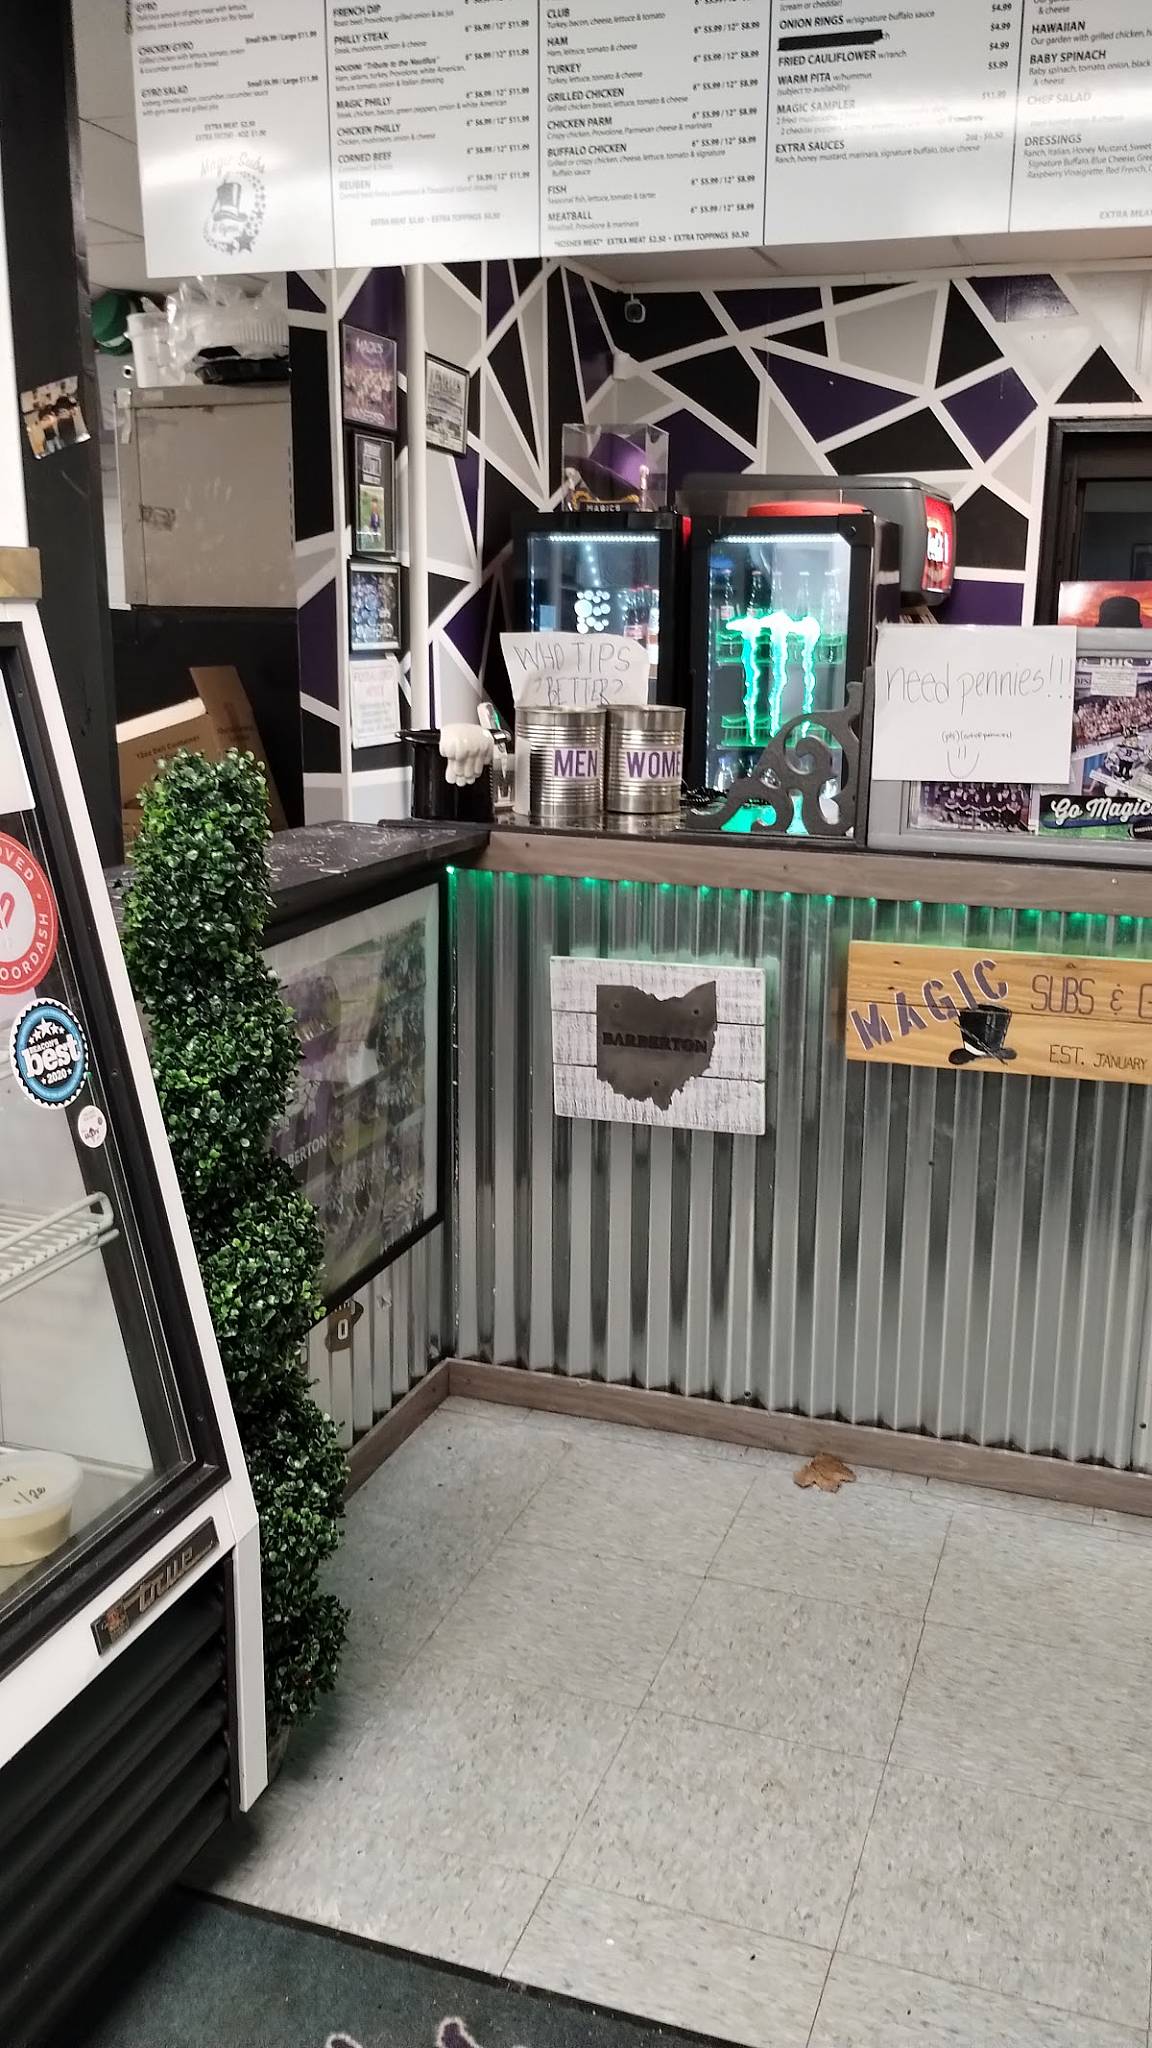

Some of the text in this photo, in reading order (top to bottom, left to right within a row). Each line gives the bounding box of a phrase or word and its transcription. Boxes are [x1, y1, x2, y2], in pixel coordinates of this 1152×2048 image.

[366, 4, 381, 14] DIP
[546, 8, 570, 18] CLUB
[780, 18, 812, 30] ONION
[814, 16, 844, 26] RINGS
[1032, 21, 1086, 34] HAWAIIAN
[334, 32, 390, 44] PHILLY STEAK
[547, 36, 568, 46] HAM
[1046, 36, 1072, 46] garden
[1073, 34, 1088, 42] with
[1090, 32, 1114, 42] grilled
[778, 56, 806, 66] FRIED
[808, 50, 876, 64] CAULIFLOWER
[1030, 50, 1106, 64] BABY SPINACH
[547, 64, 581, 74] TURKEY
[1029, 67, 1046, 76] Baby
[1132, 60, 1151, 68] black
[778, 74, 808, 85] WARM
[810, 72, 830, 82] PITA
[547, 88, 624, 102] GRILLED CHICKEN
[1027, 92, 1092, 105] CHEF SALAD
[777, 100, 855, 114] MAGIC SAMPLER
[547, 116, 612, 130] CHICKEN PARM
[337, 124, 400, 136] CHICKEN PHILLY
[776, 140, 845, 153] EXTRA SAUCES
[1024, 134, 1082, 146] DRESSINGS
[547, 144, 626, 157] BUFFALO CHICKEN
[338, 152, 392, 164] CORNED BEEF
[548, 185, 567, 194] FISH
[548, 211, 592, 220] MEATBALL
[1100, 210, 1128, 219] EXTRA
[674, 234, 694, 242] EXTRA
[696, 232, 728, 240] TOPPINGS
[514, 642, 630, 672] WHO TIPS
[887, 662, 950, 704] need
[957, 656, 1073, 716] pennies!!!
[554, 750, 598, 777] MEN
[1051, 798, 1083, 825] Go
[850, 959, 1008, 1051] MAGIC
[1031, 974, 1096, 1016] SUBS
[1110, 983, 1124, 1016] &
[602, 1032, 708, 1054] BARBERTON
[22, 1034, 81, 1078] best
[1050, 1044, 1148, 1070] EST. JANUARY
[48, 1068, 67, 1084] 2020
